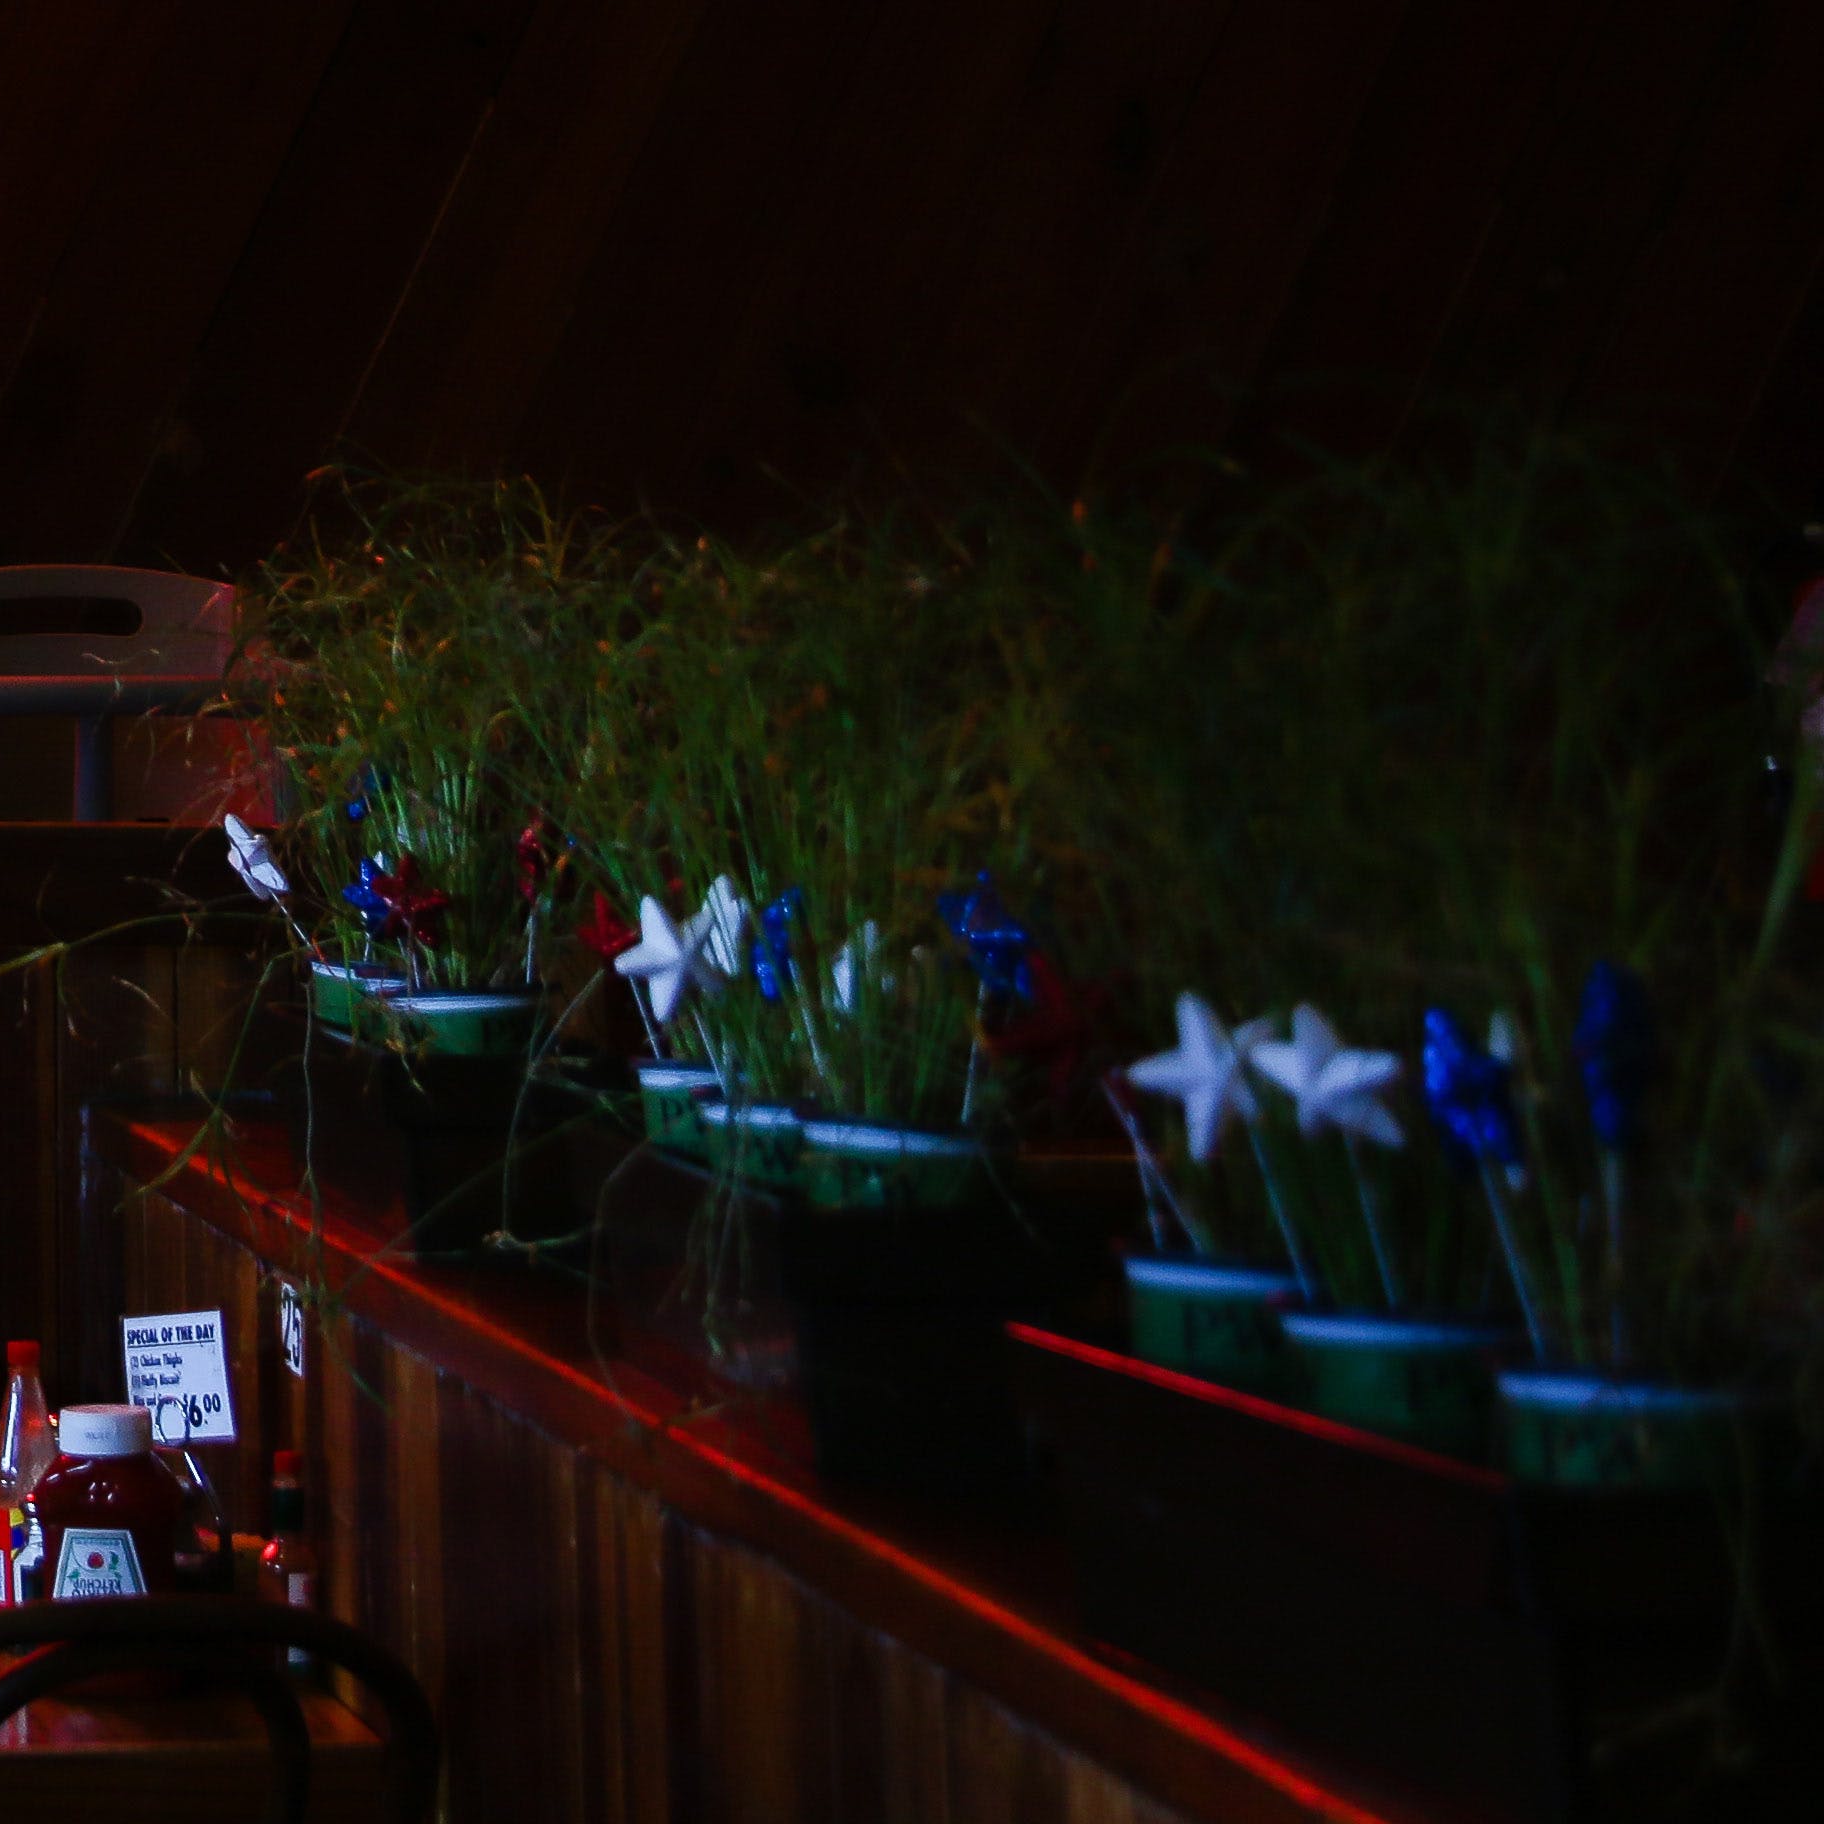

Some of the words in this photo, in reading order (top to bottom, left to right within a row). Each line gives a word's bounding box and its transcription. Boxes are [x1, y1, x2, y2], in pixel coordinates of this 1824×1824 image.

[127, 1328, 158, 1344] SPECIAL
[161, 1327, 172, 1342] OF
[176, 1326, 192, 1341] THE
[196, 1324, 215, 1339] DAY
[282, 1288, 303, 1368] 25
